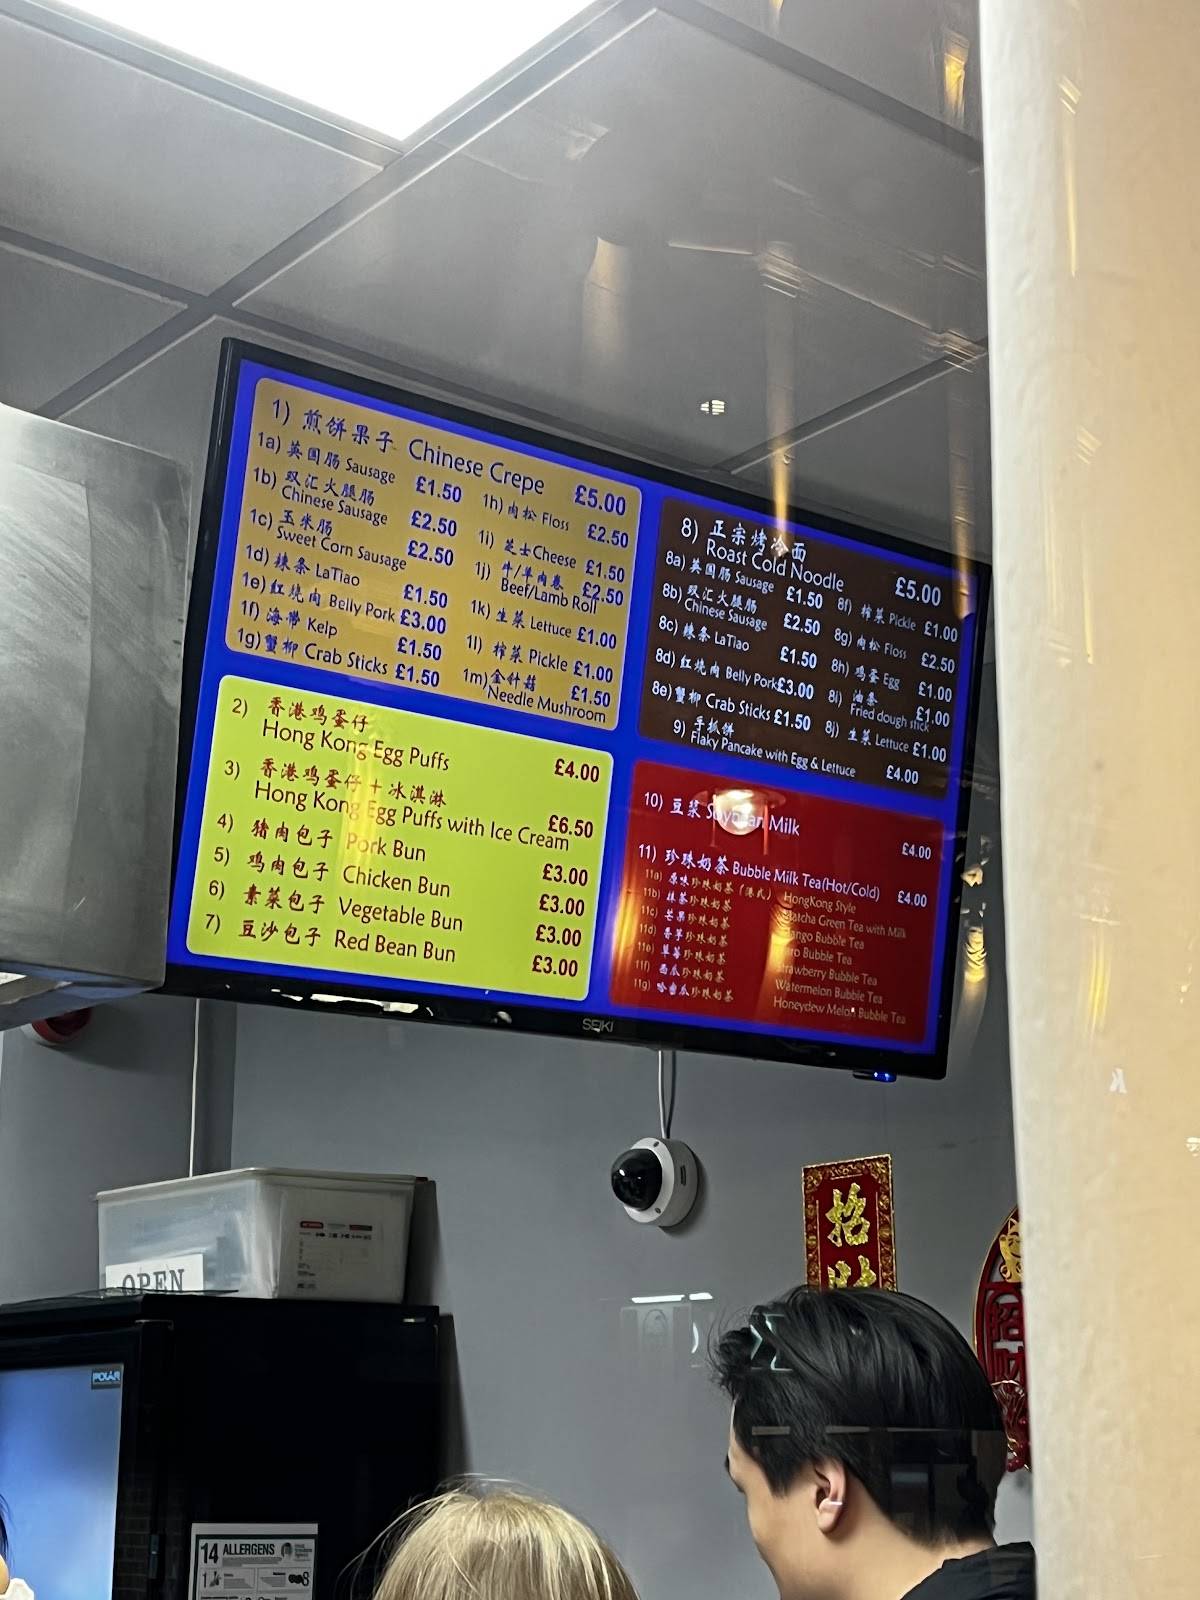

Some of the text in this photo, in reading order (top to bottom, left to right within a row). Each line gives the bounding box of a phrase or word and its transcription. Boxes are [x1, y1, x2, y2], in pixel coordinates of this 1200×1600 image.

[254, 467, 276, 489] 1b)
[258, 432, 280, 454] 1a)
[346, 458, 395, 485] Sausage
[416, 476, 462, 503] £1.50
[273, 399, 289, 425] 1)
[409, 439, 483, 477] Chinese
[490, 463, 545, 495] Crepe
[574, 485, 626, 516] £5.00
[250, 508, 272, 529] 1c)
[282, 486, 457, 537] Chinese Sausage £2.50
[483, 494, 503, 514] 1h)
[588, 524, 628, 548] £2.50
[681, 518, 698, 544] 8)
[277, 526, 453, 572] Sweet Corn Sausage £2.50
[586, 560, 625, 583] £1.50
[246, 545, 447, 608] 1d) LaTiao £1.50
[662, 583, 682, 603] 8b)
[666, 551, 823, 609] 8a) Sausage £1.50
[707, 538, 941, 607] Roast Cold Noodle £5.00
[242, 572, 446, 634] 1e) Belly Pork £3.00
[501, 578, 623, 614] Beef/Lamb Roll £2.50
[684, 598, 820, 636] Chinese Sausage £2.50
[307, 618, 441, 661] Kelp £1.50
[471, 600, 490, 620] 1k)
[530, 616, 571, 638] Lettuce
[577, 627, 616, 649] £1.00
[659, 615, 817, 669] 8c) £1.50
[924, 621, 957, 642] £1.00
[305, 643, 439, 687] Crab Sticks £1.50
[529, 649, 613, 683] Pickle £1.00
[834, 628, 852, 647] 8g)
[921, 652, 955, 673] £2.50
[656, 648, 814, 700] 8d) Belly £3.00
[831, 658, 952, 702] 8h) Egg £1.00
[232, 697, 368, 733] 2) 香港鸡蛋仔
[488, 684, 610, 723] Needle Mushroom £1.50
[652, 681, 810, 731] 8e) Crab Sticks £1.50
[850, 703, 949, 727] Fried £1.00
[263, 719, 599, 783] Hong Kong Egg Puffs £4.00
[673, 720, 685, 738] 9)
[224, 760, 240, 780] 3)
[722, 737, 919, 784] Pancake with Egg & Lettuce £4.00
[913, 742, 946, 762] £1.00
[255, 781, 593, 852] Hong Puffs with Ice Cream £6.50
[644, 792, 662, 812] 10)
[769, 815, 799, 836] Milk
[902, 843, 931, 860] £4.00
[217, 813, 233, 832] 4)
[393, 839, 425, 861] Bun
[543, 863, 588, 887] £3.00
[214, 847, 230, 866] 5)
[343, 864, 412, 892] Chicken
[418, 876, 450, 898] Bun
[539, 894, 585, 916] £3.00
[639, 844, 656, 863] 11)
[733, 861, 771, 880] Bubble
[774, 869, 799, 885] Milk
[897, 890, 927, 907] £4.00
[209, 880, 224, 900] 6)
[339, 897, 424, 927] Vegetable
[431, 910, 462, 931] Bun
[536, 924, 581, 947] £3.00
[784, 892, 832, 913] HongKong
[835, 901, 856, 914] Style
[205, 914, 221, 934] 7)
[335, 929, 369, 952] Red
[376, 934, 417, 957] Bean
[423, 942, 455, 962] Bun
[532, 955, 578, 977] £3.00
[123, 1269, 184, 1296] OPEN
[201, 1542, 218, 1564] 14
[223, 1544, 275, 1555] ALLERGENS
